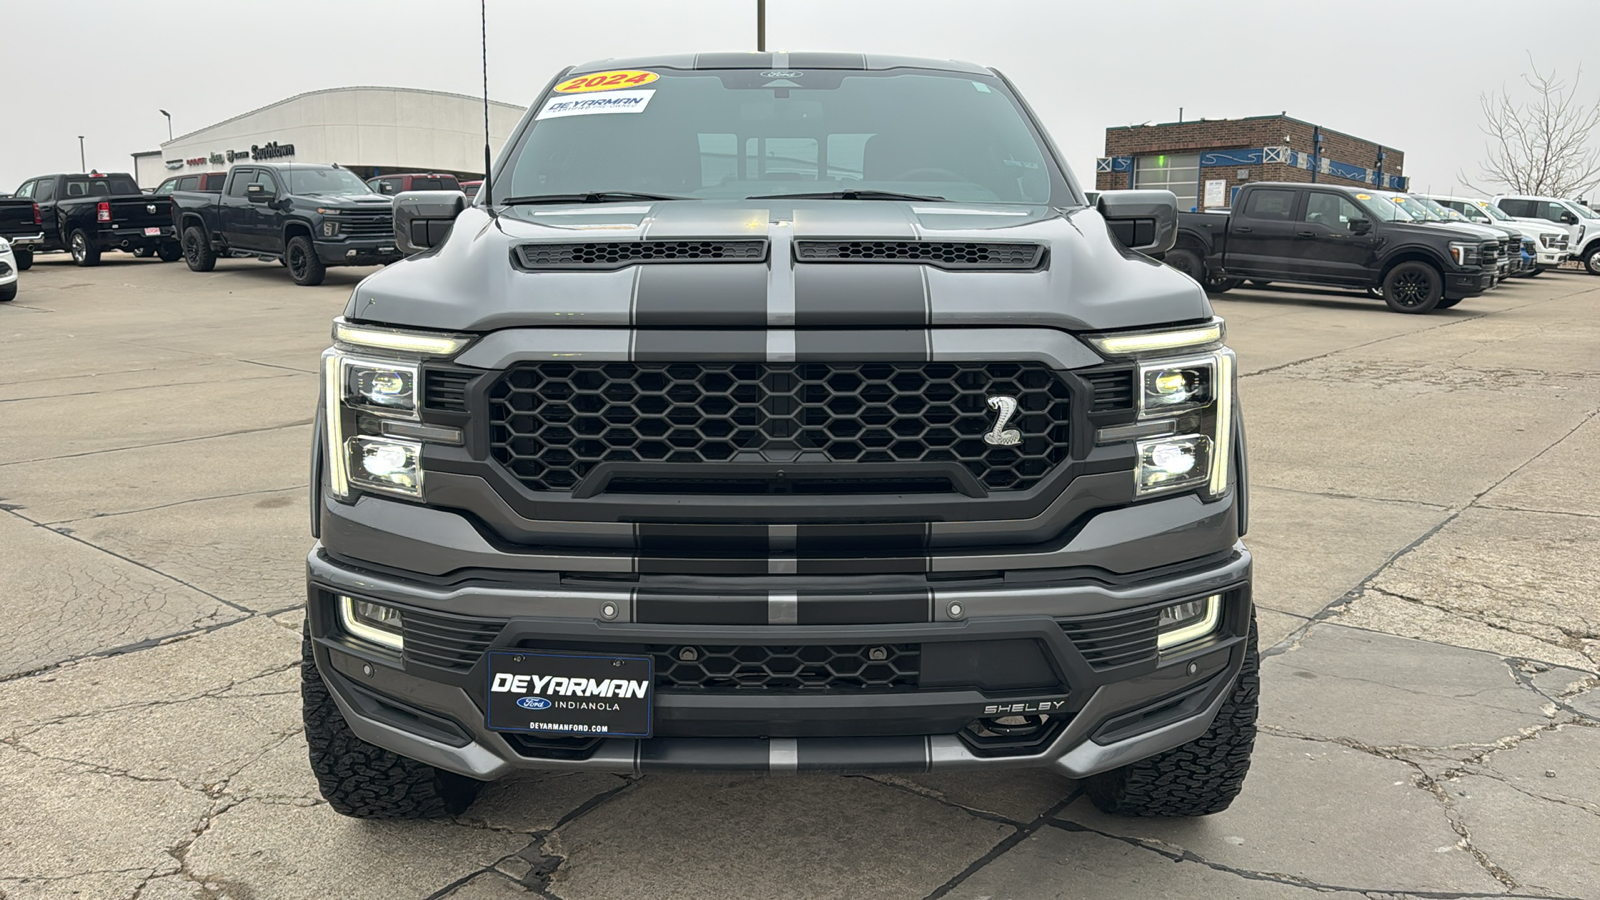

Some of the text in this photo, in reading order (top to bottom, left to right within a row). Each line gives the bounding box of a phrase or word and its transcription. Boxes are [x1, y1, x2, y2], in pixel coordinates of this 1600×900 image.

[562, 73, 650, 91] 2024
[549, 97, 644, 111] DEYARMAN
[251, 141, 294, 161] Southtown
[491, 673, 649, 698] DEYARMAN
[523, 697, 620, 711] Ford INDIANOLA
[984, 701, 1065, 714] SHELBY
[530, 722, 608, 732] DEYARMANFORD.COM
